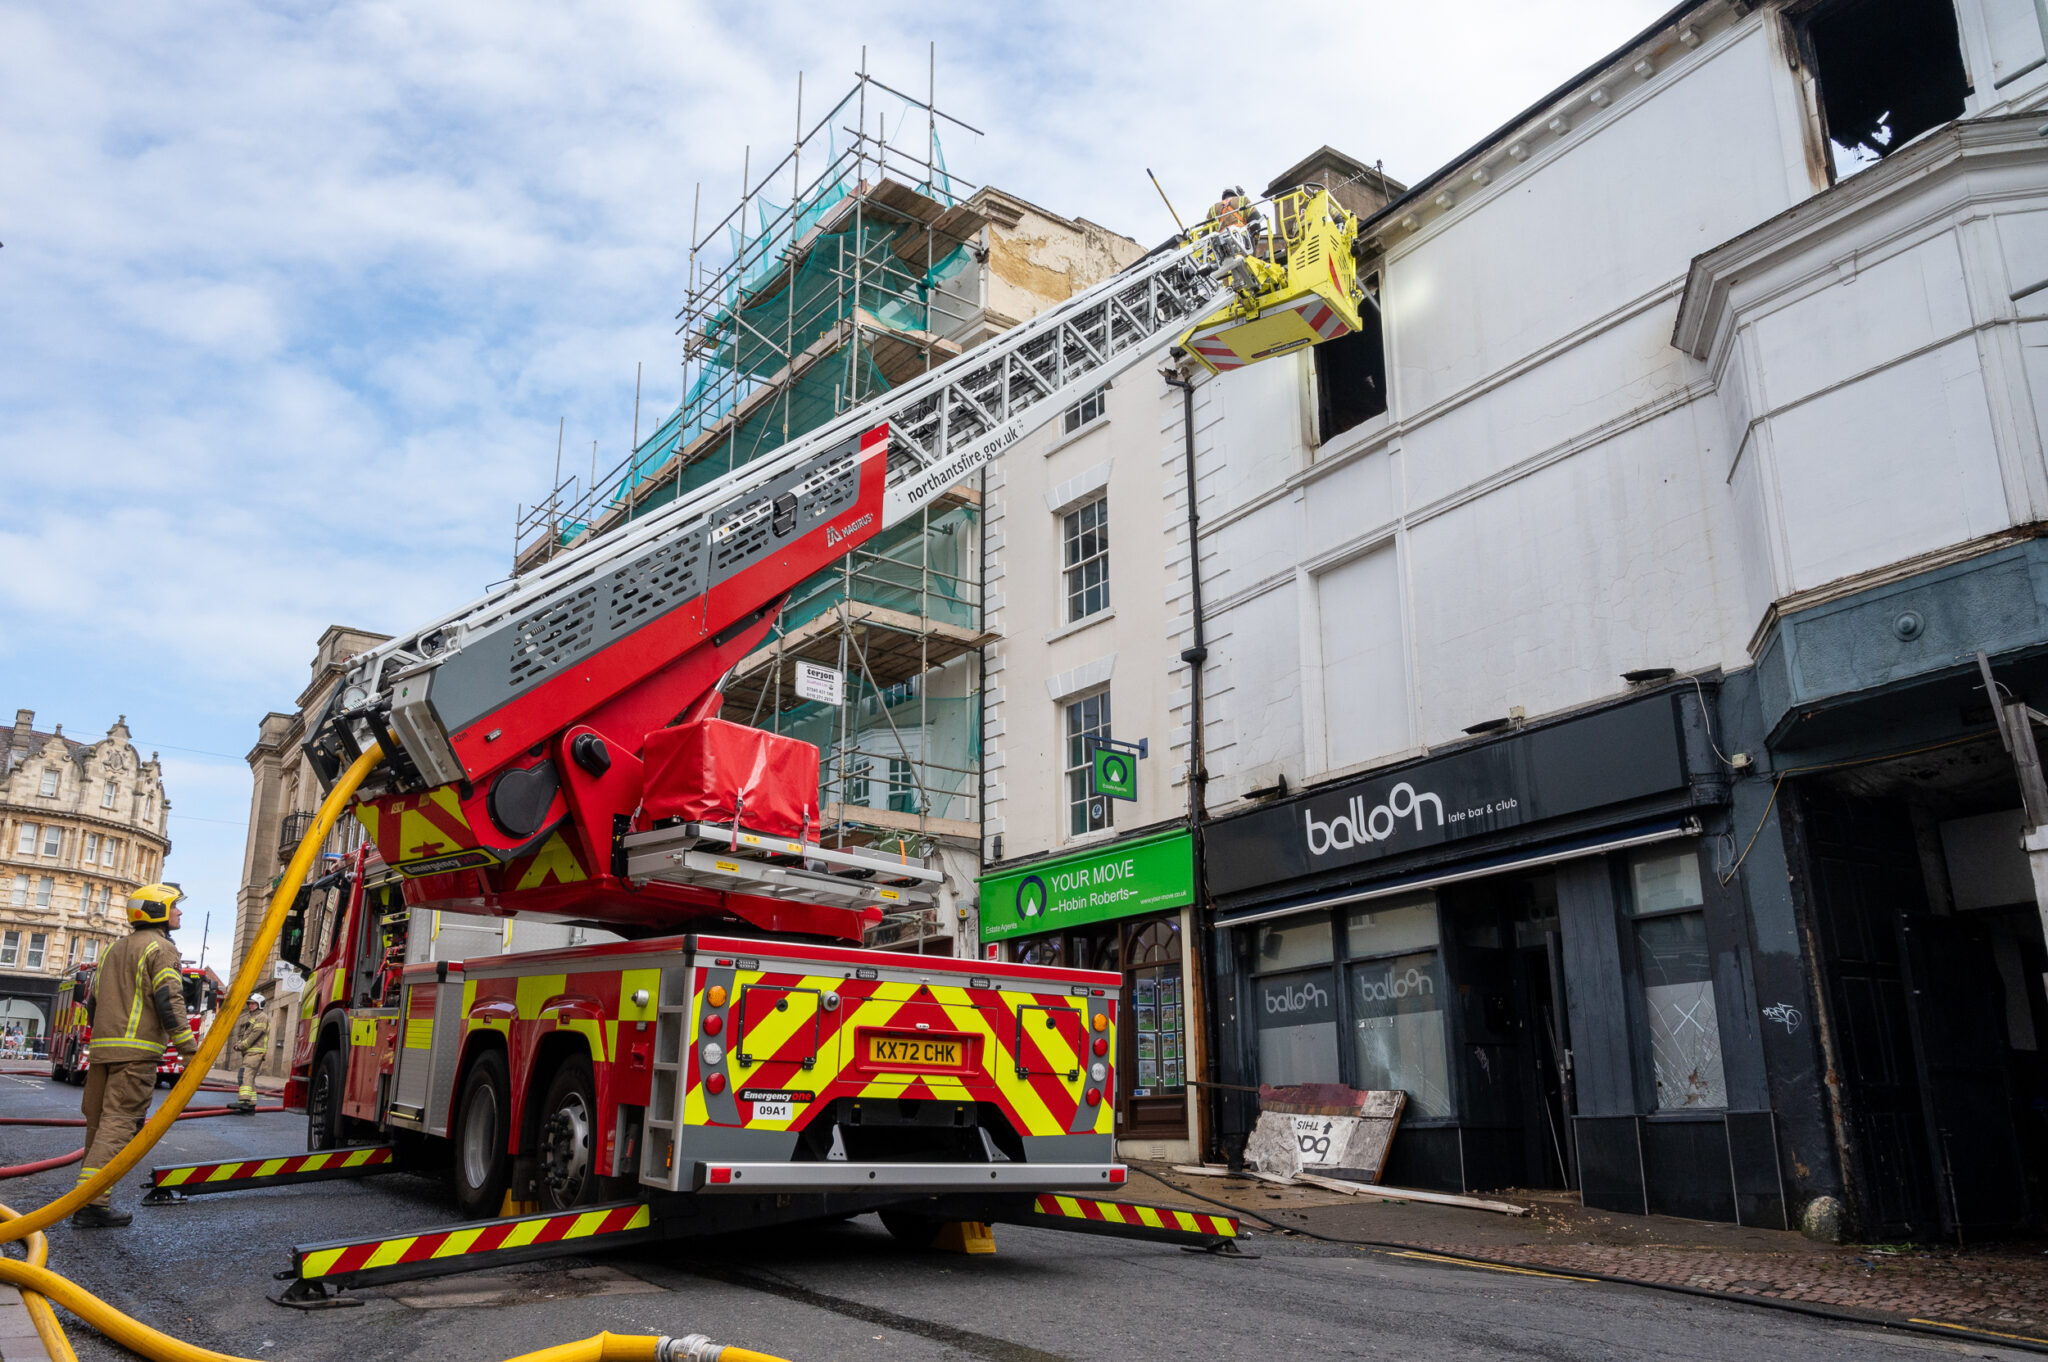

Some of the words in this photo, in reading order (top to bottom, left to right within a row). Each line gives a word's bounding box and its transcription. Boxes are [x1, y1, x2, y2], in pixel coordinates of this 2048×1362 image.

[907, 427, 1019, 503] northantsfire.gov.uk
[841, 513, 872, 538] MAGIRUS
[1304, 782, 1444, 855] balloon
[1448, 811, 1466, 823] late
[1467, 807, 1484, 818] bar
[1486, 803, 1493, 814] &
[1495, 797, 1518, 811] club
[404, 859, 461, 874] Emergency
[1050, 869, 1090, 893] YOUR
[1093, 859, 1134, 885] MOVE
[985, 925, 1001, 935] Estate
[1001, 922, 1018, 933] Agents
[1361, 968, 1433, 1001] balloon
[1265, 982, 1328, 1014] balloon
[876, 1041, 920, 1061] KX72
[924, 1043, 955, 1063] CHK
[743, 1090, 792, 1102] Emergency
[759, 1105, 786, 1115] 09A1
[1297, 1120, 1319, 1131] THIS
